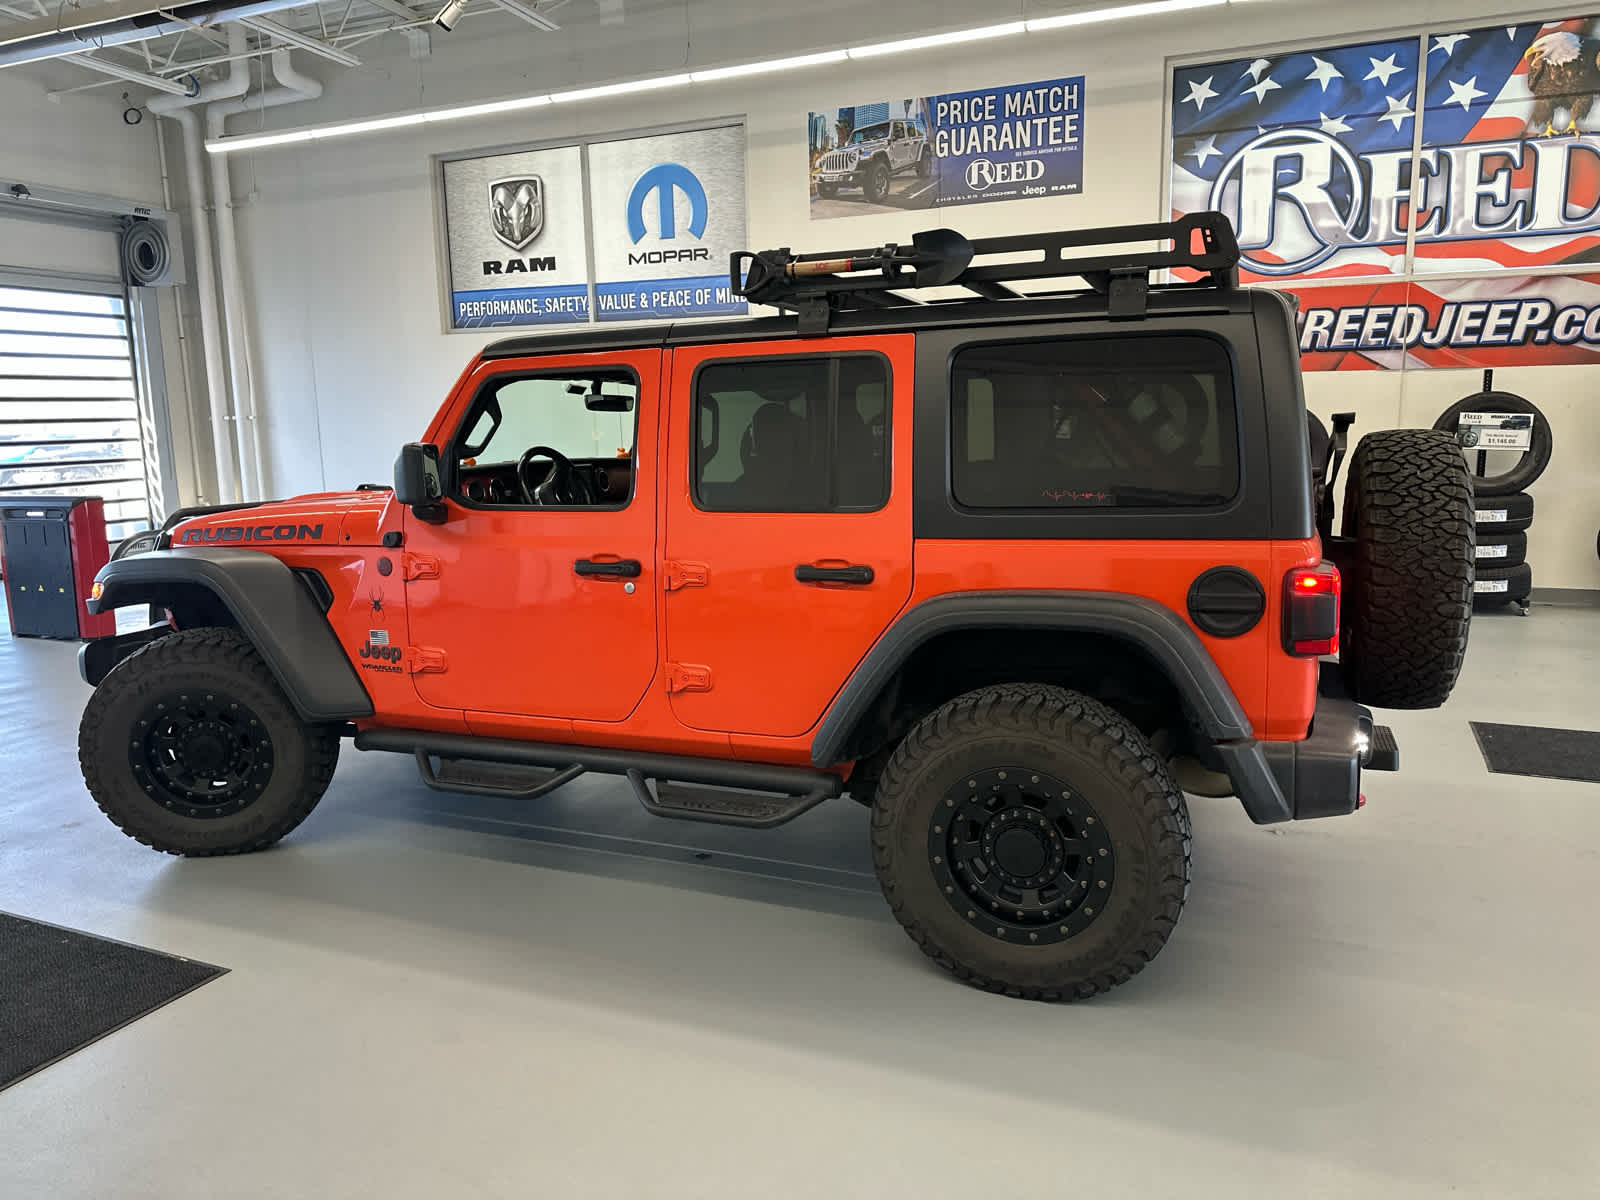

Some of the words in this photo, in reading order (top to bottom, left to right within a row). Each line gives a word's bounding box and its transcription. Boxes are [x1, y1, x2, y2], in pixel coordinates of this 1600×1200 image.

[937, 95, 997, 127] PRICE
[1004, 84, 1078, 118] MATCH
[935, 114, 1079, 158] GUARANTEE
[967, 159, 1045, 188] REED
[1022, 185, 1047, 196] Jeep
[1222, 130, 1600, 264] REED
[482, 256, 557, 276] RAM
[628, 248, 709, 265] MOPAR
[460, 298, 542, 317] PERFORMANCE,
[599, 293, 636, 310] VALUE
[639, 293, 649, 308] &
[653, 290, 692, 307] PEACE
[695, 289, 711, 305] OF
[181, 524, 324, 543] RUBICON
[359, 640, 402, 664] Jeep
